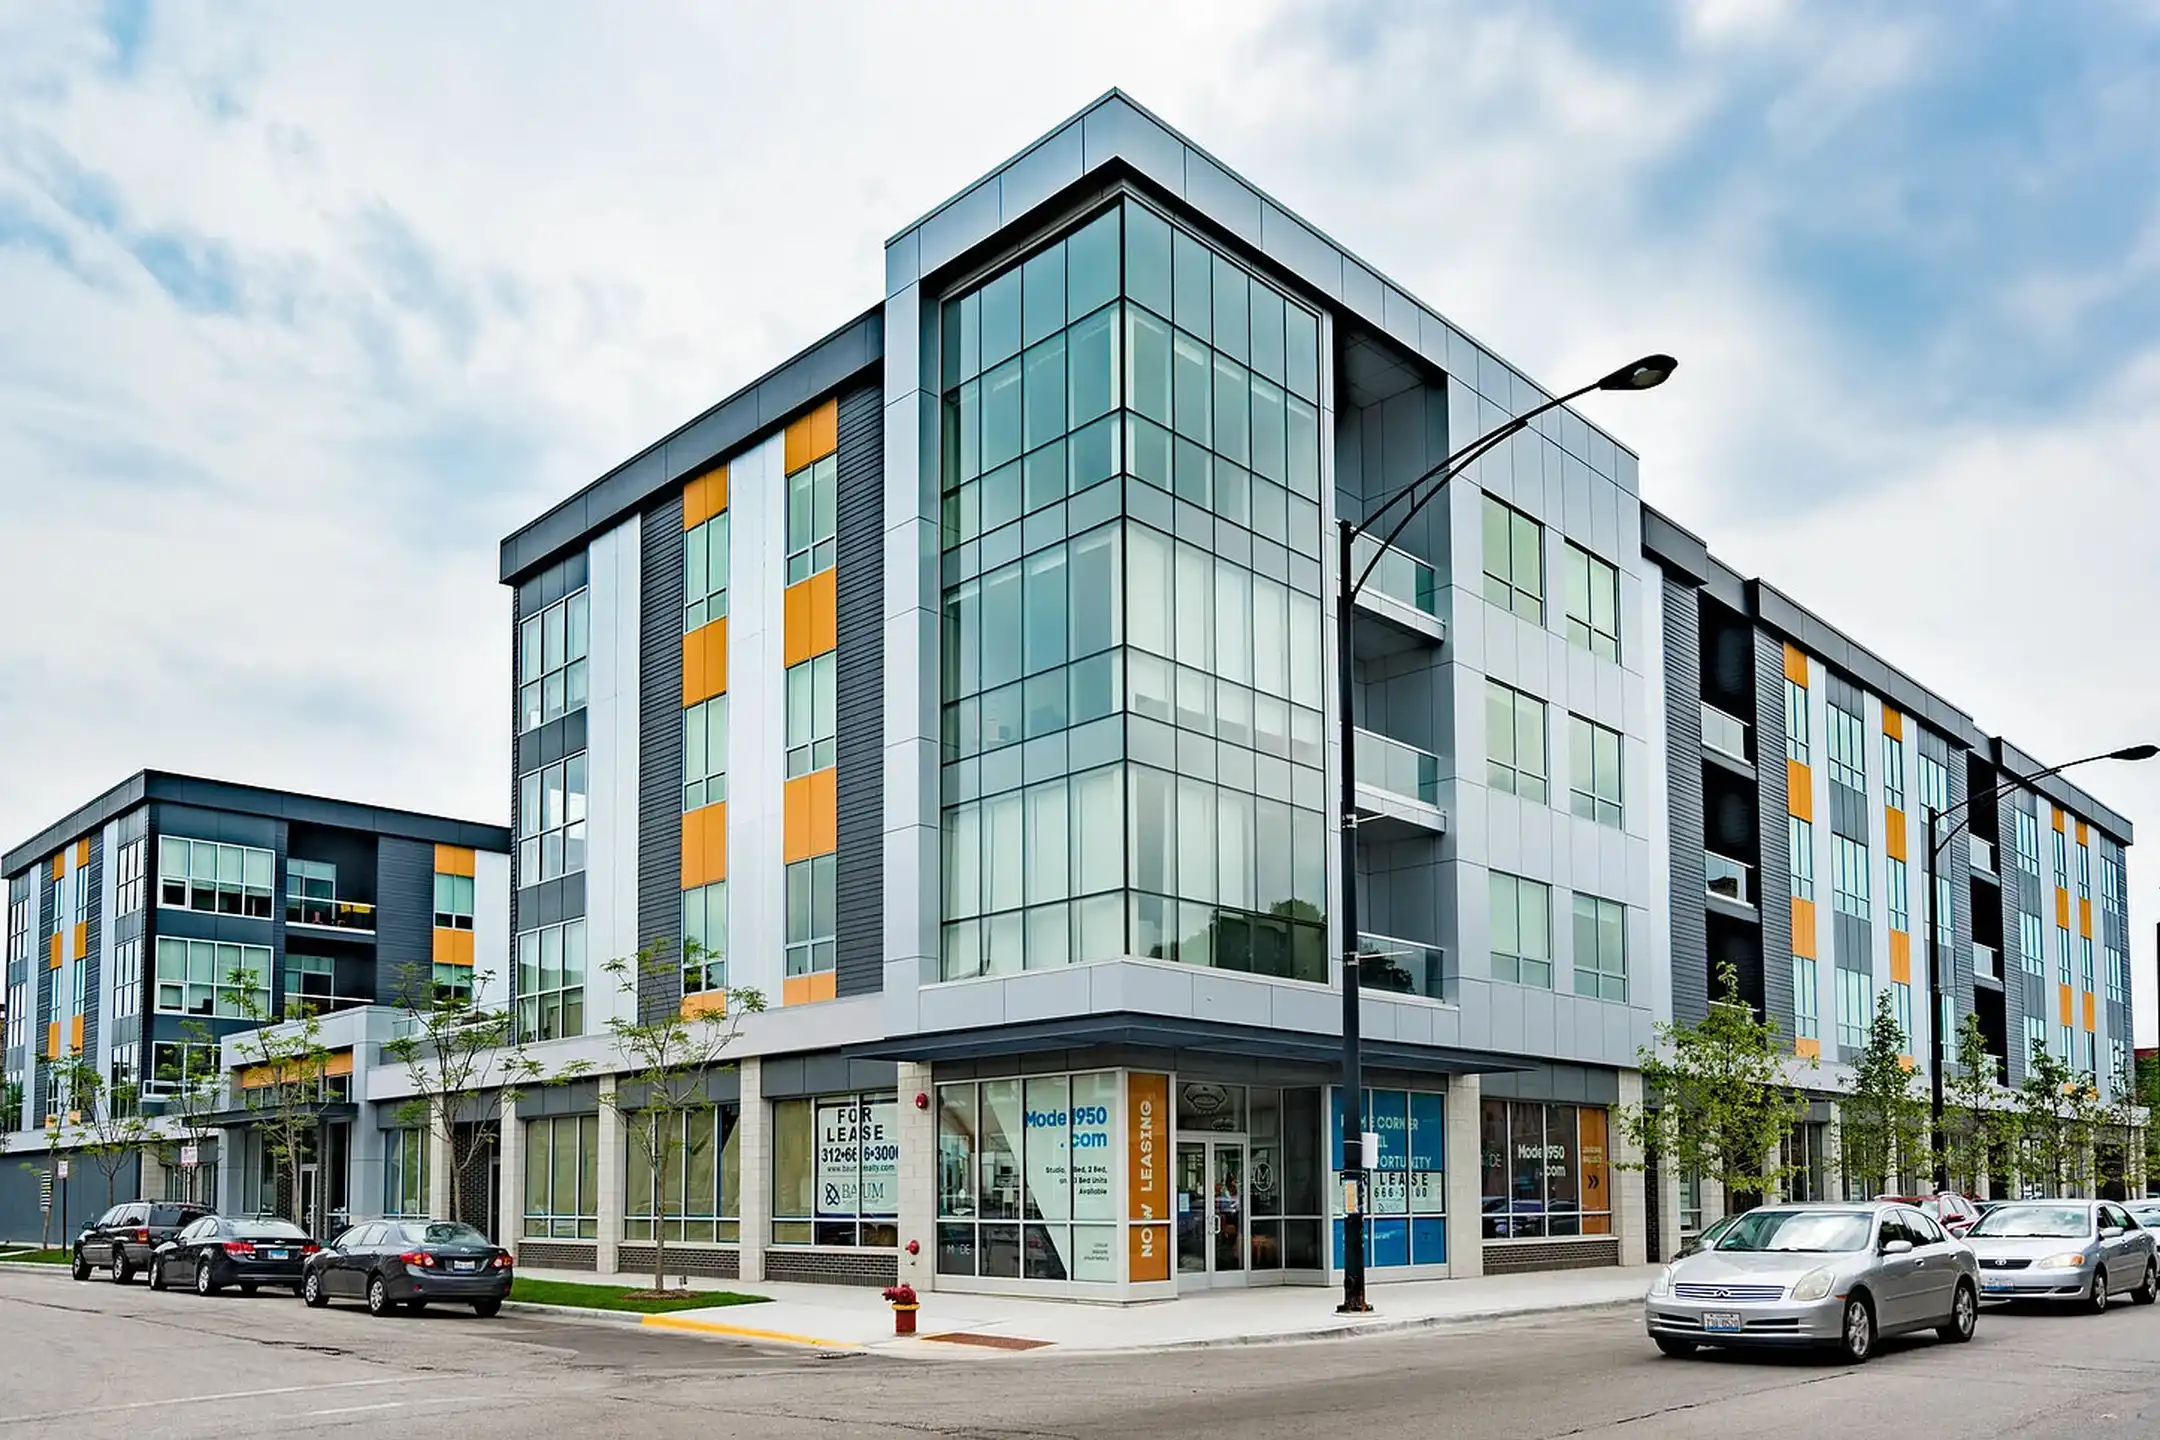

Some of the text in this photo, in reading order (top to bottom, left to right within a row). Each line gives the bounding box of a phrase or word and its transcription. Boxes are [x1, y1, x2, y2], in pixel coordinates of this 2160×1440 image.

[838, 1107, 872, 1124] FOR
[827, 1125, 883, 1142] LEASE
[1060, 1132, 1107, 1148] .com
[1140, 1101, 1153, 1257] NOW LEASING
[1339, 1172, 1428, 1187] FR LEASE
